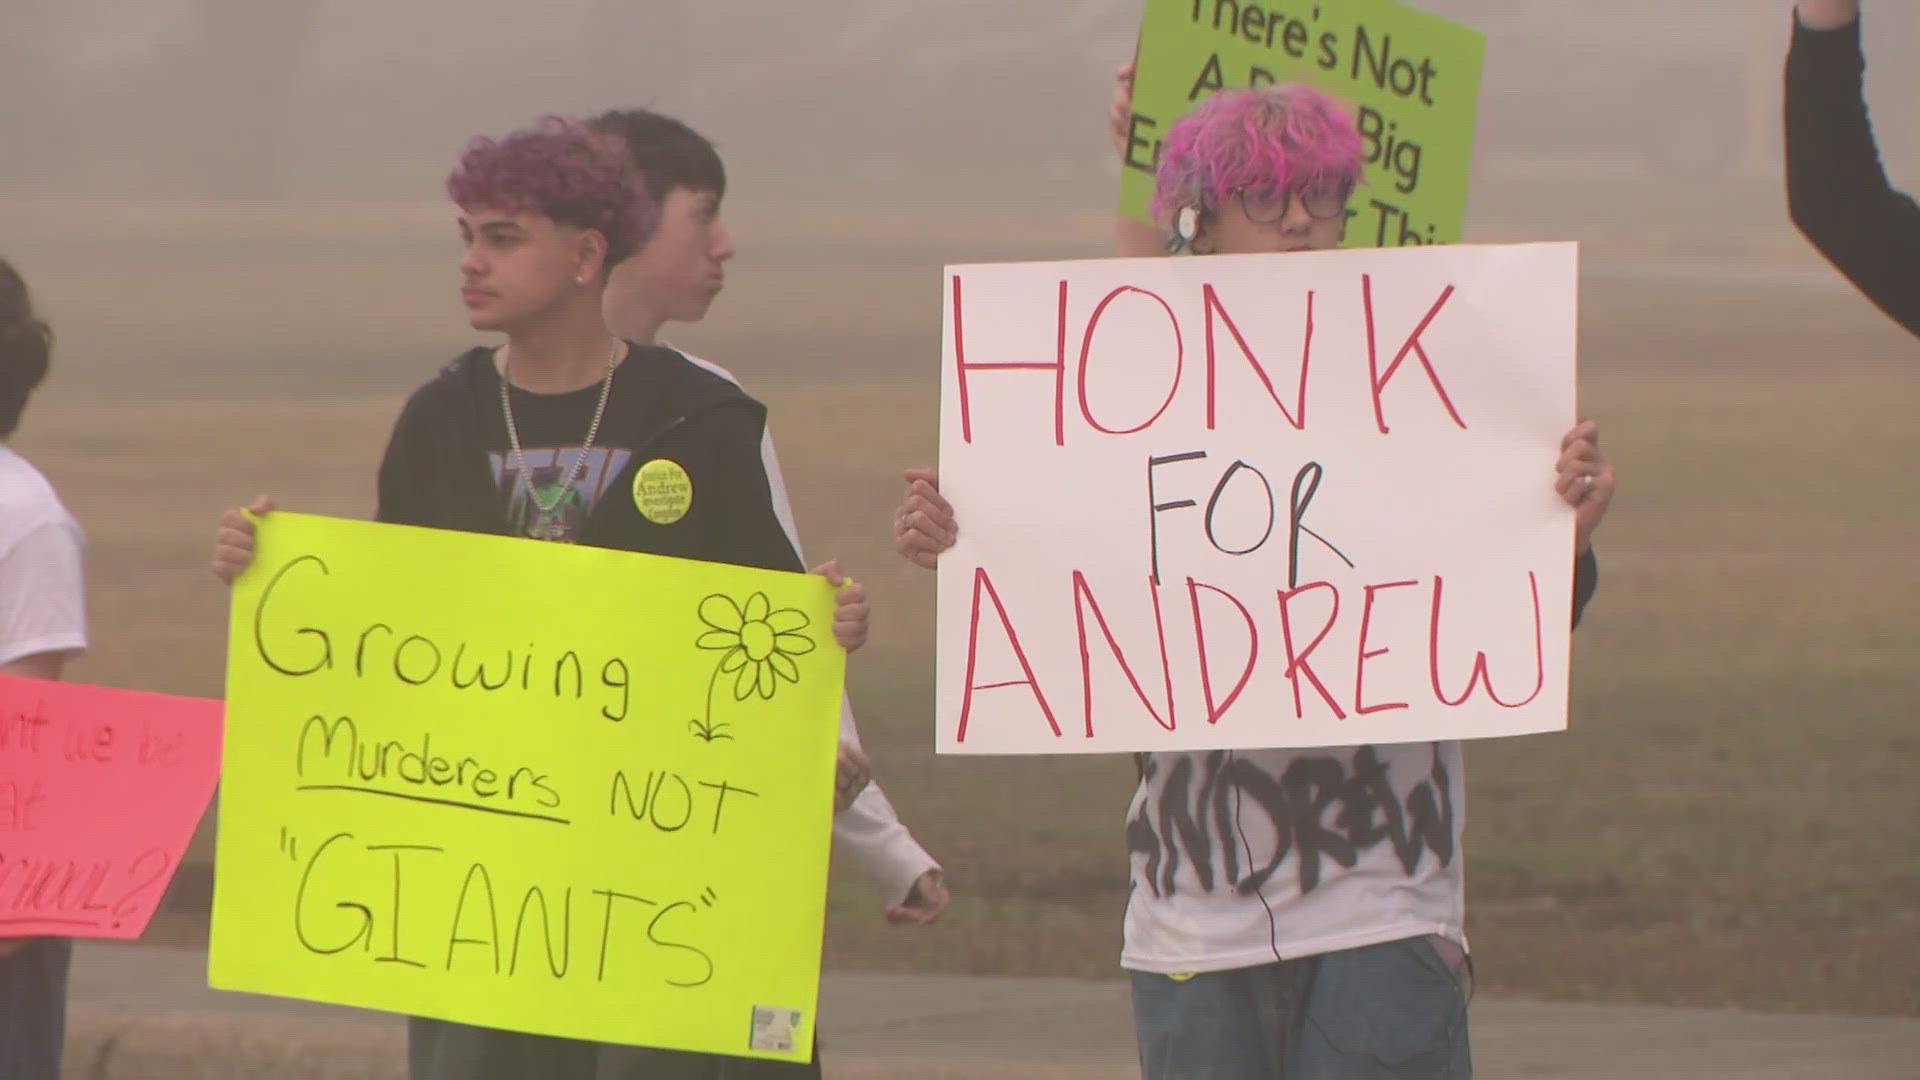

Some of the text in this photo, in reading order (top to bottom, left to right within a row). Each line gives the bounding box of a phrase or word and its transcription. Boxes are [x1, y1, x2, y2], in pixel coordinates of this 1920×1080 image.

[1187, 53, 1225, 102] A
[1350, 24, 1437, 107] Not
[1356, 106, 1422, 194] Big
[1369, 198, 1448, 248] Thi
[952, 273, 1468, 447] HONK
[636, 481, 689, 496] Andrew
[1148, 451, 1355, 590] FOR
[254, 554, 630, 722] Growing
[956, 566, 1544, 744] ANDREW
[297, 714, 760, 835] Murderers NOT
[279, 825, 718, 988] "GIANTS"
